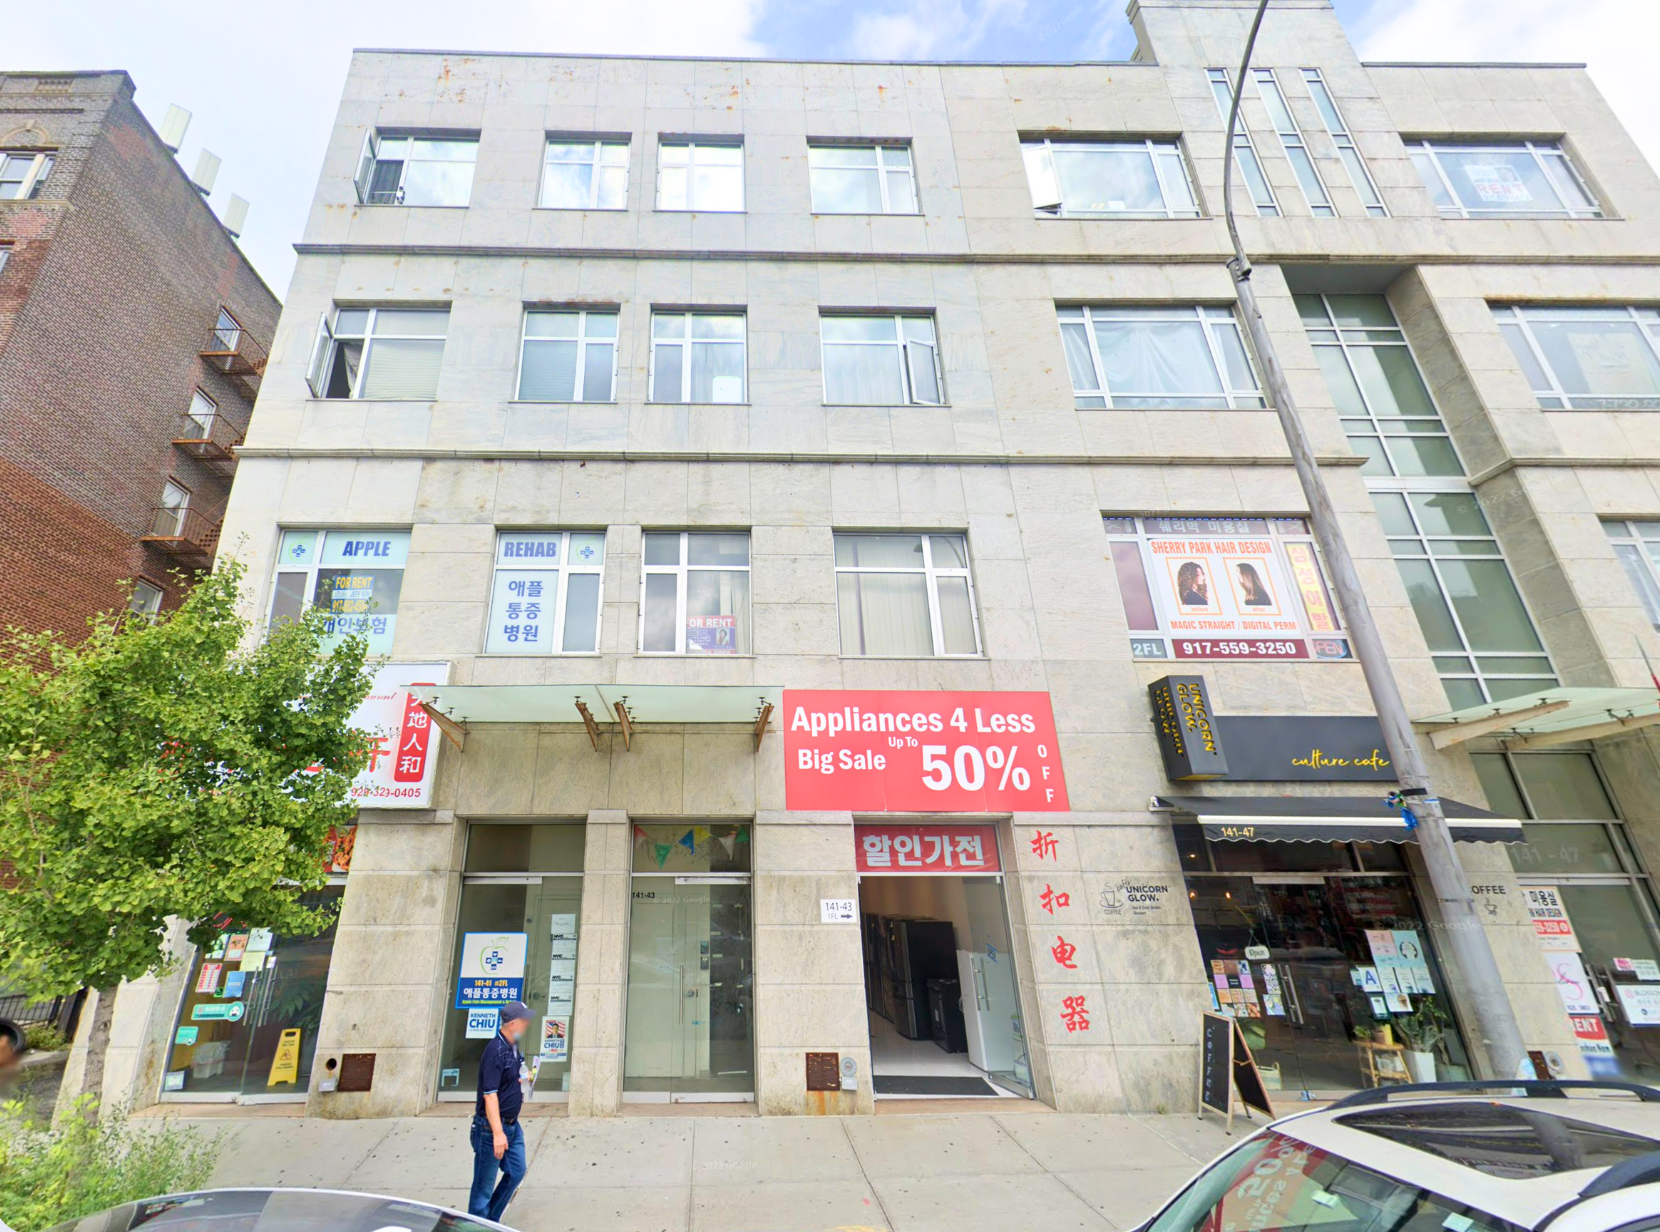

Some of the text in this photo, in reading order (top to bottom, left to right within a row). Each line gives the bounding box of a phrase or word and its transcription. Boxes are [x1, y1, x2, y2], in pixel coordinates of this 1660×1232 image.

[342, 541, 391, 556] APPLE
[504, 542, 556, 557] REHAB
[1151, 541, 1272, 554] SHERRY PARK HAIR DESIGN
[335, 577, 373, 589] FOR RENT
[508, 581, 543, 597] 애플
[505, 602, 541, 619] 통증
[706, 619, 732, 627] RENT
[1171, 621, 1296, 630] MAGIC STRAIGHT DIGITAL PERM
[504, 625, 539, 642] 병원
[1133, 643, 1161, 655] 2FL
[1183, 642, 1297, 655] 917-559-3250
[791, 707, 1035, 737] Appliances 4 Less
[888, 736, 918, 748] Up To
[798, 749, 886, 774] Big Sale
[1292, 749, 1389, 770] culture cafe
[922, 745, 1030, 791] 50%
[1221, 827, 1255, 838] 141-47
[862, 835, 985, 867] 할인가전
[825, 902, 853, 912] 141-43
[1030, 830, 1089, 1032] 折扣电器
[1365, 970, 1377, 984] A
[463, 988, 517, 998] 애플통증병원
[470, 1019, 496, 1028] CHIU
